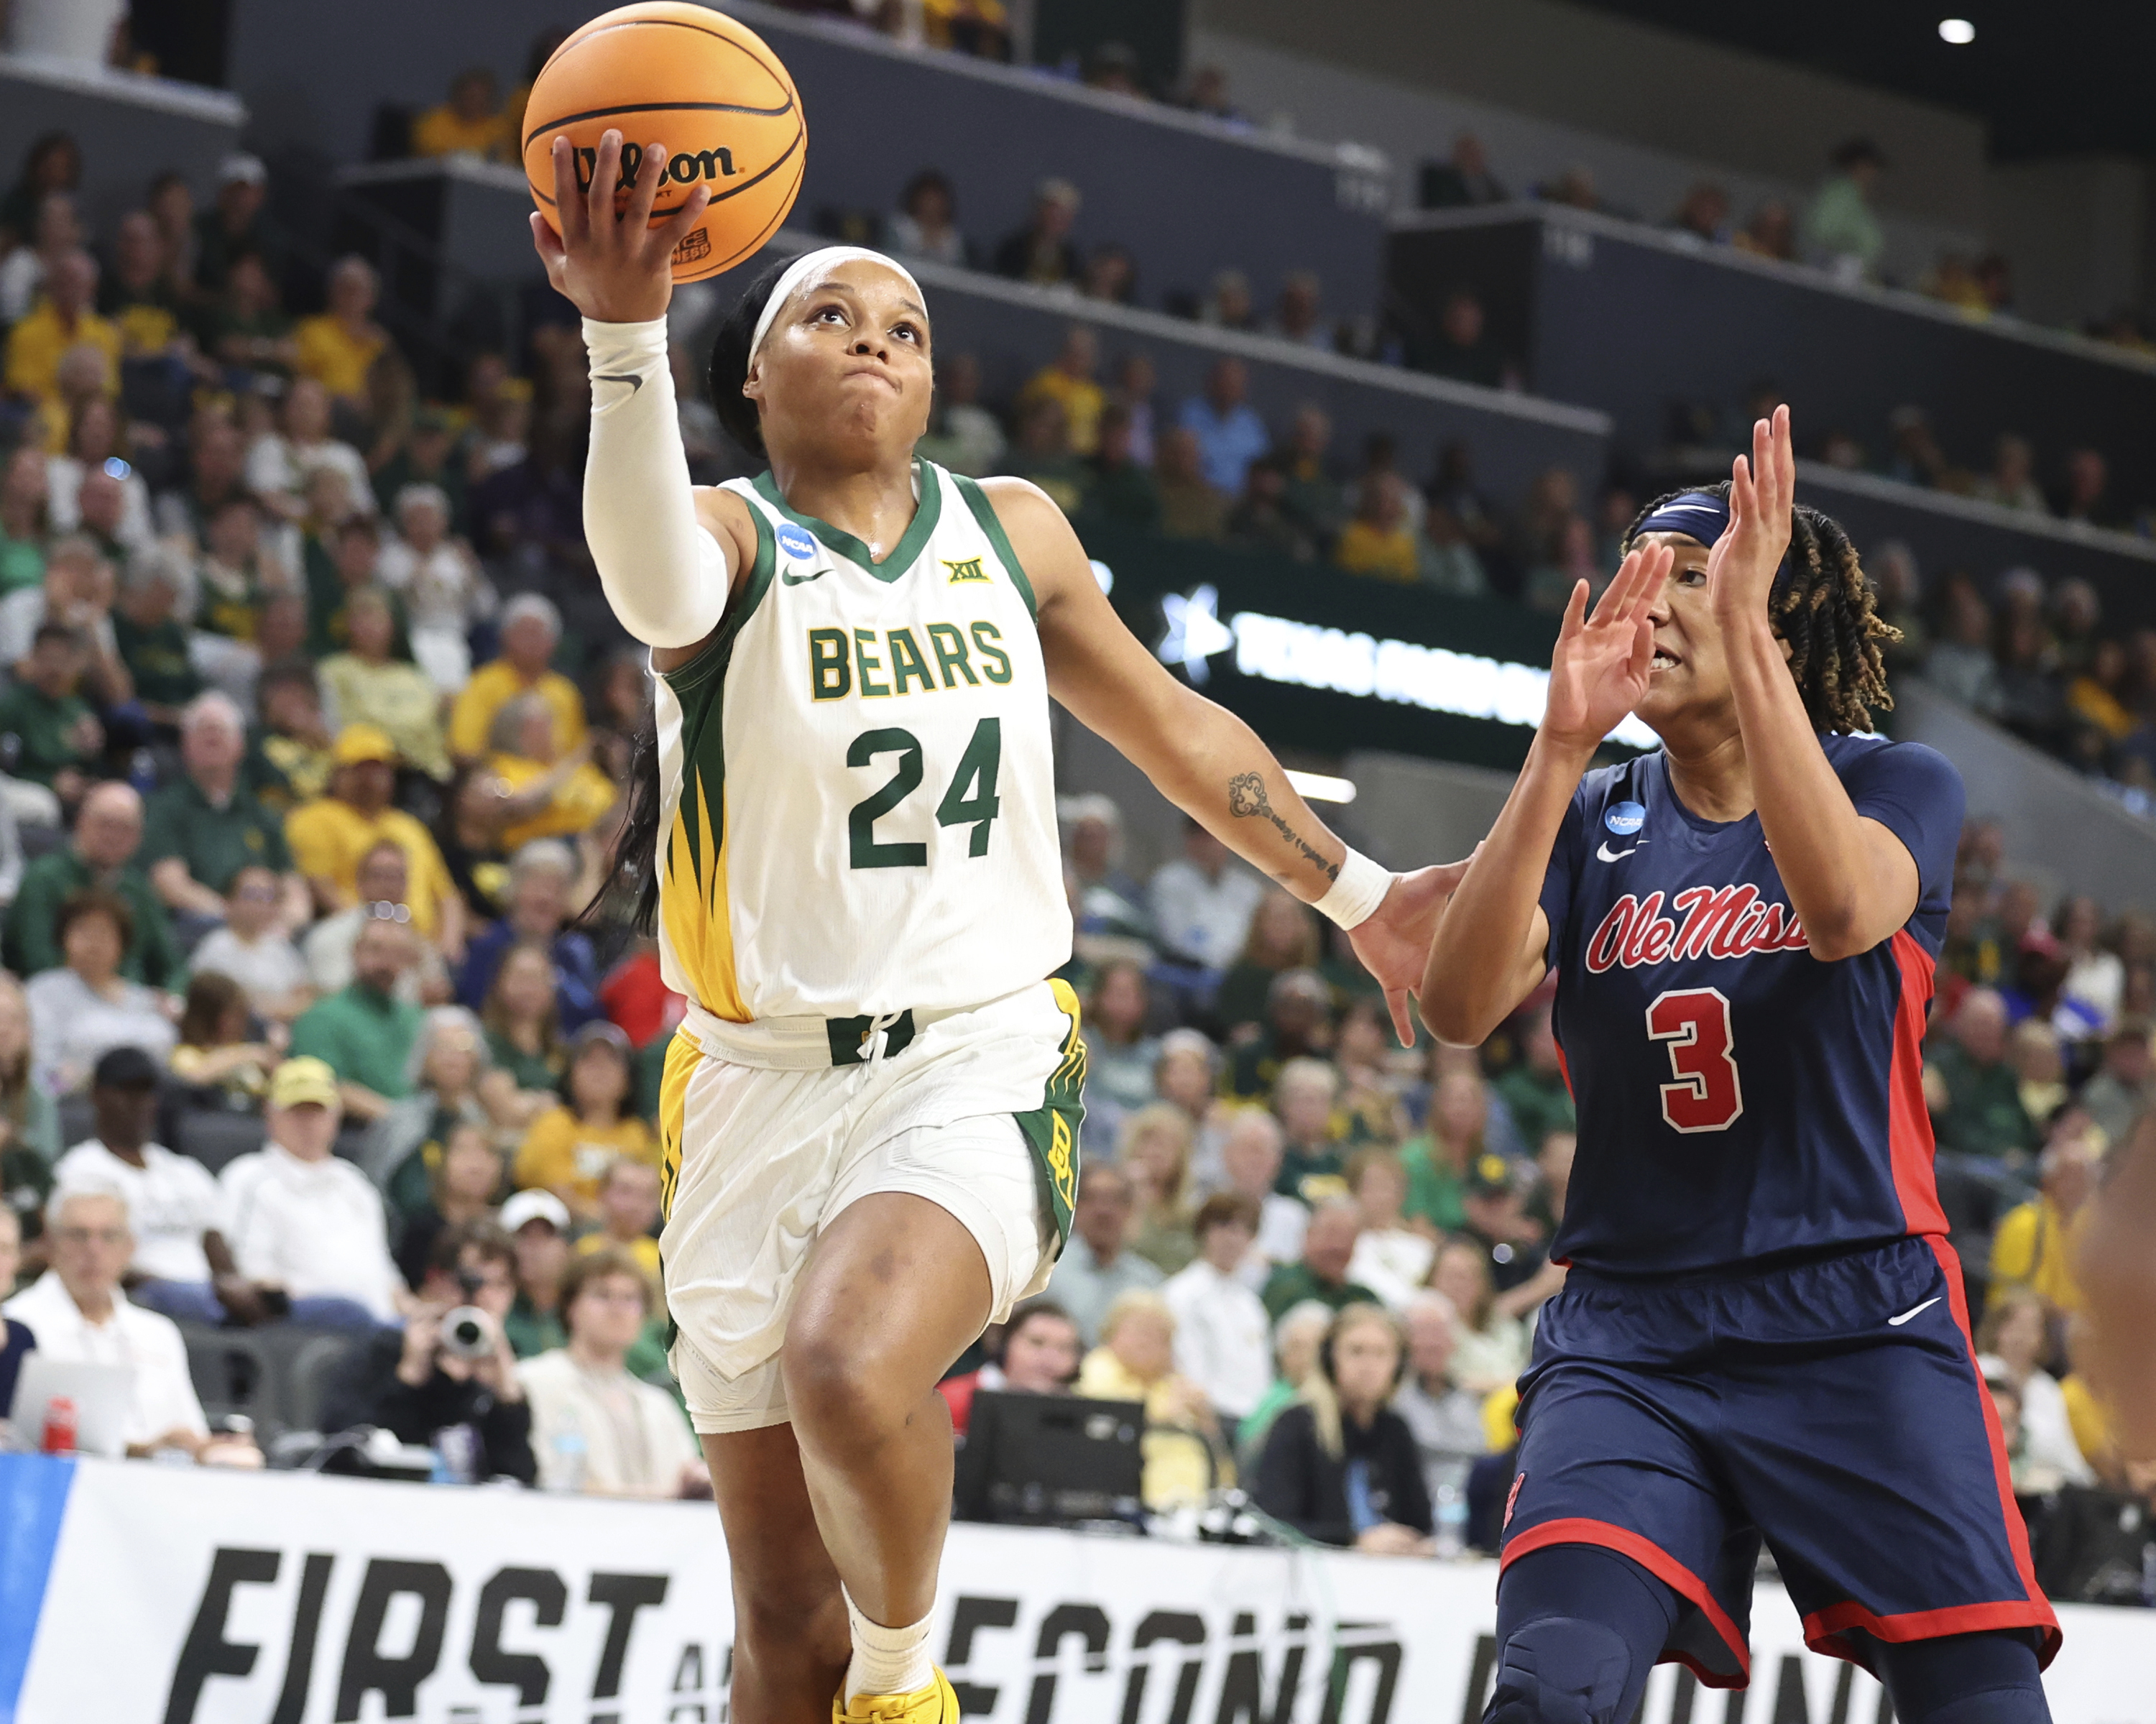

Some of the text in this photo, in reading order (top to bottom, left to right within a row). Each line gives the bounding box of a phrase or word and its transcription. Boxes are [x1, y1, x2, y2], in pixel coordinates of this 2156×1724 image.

[550, 142, 737, 194] Wlon
[781, 535, 814, 554] NCAA
[939, 556, 992, 584] XII
[807, 619, 1013, 703] BEARS
[847, 717, 1001, 870] 24
[1609, 815, 1644, 826] NCAA
[1645, 986, 1744, 1134] 3
[163, 1546, 670, 1724] FIRST
[943, 1596, 1403, 1724] ECOND
